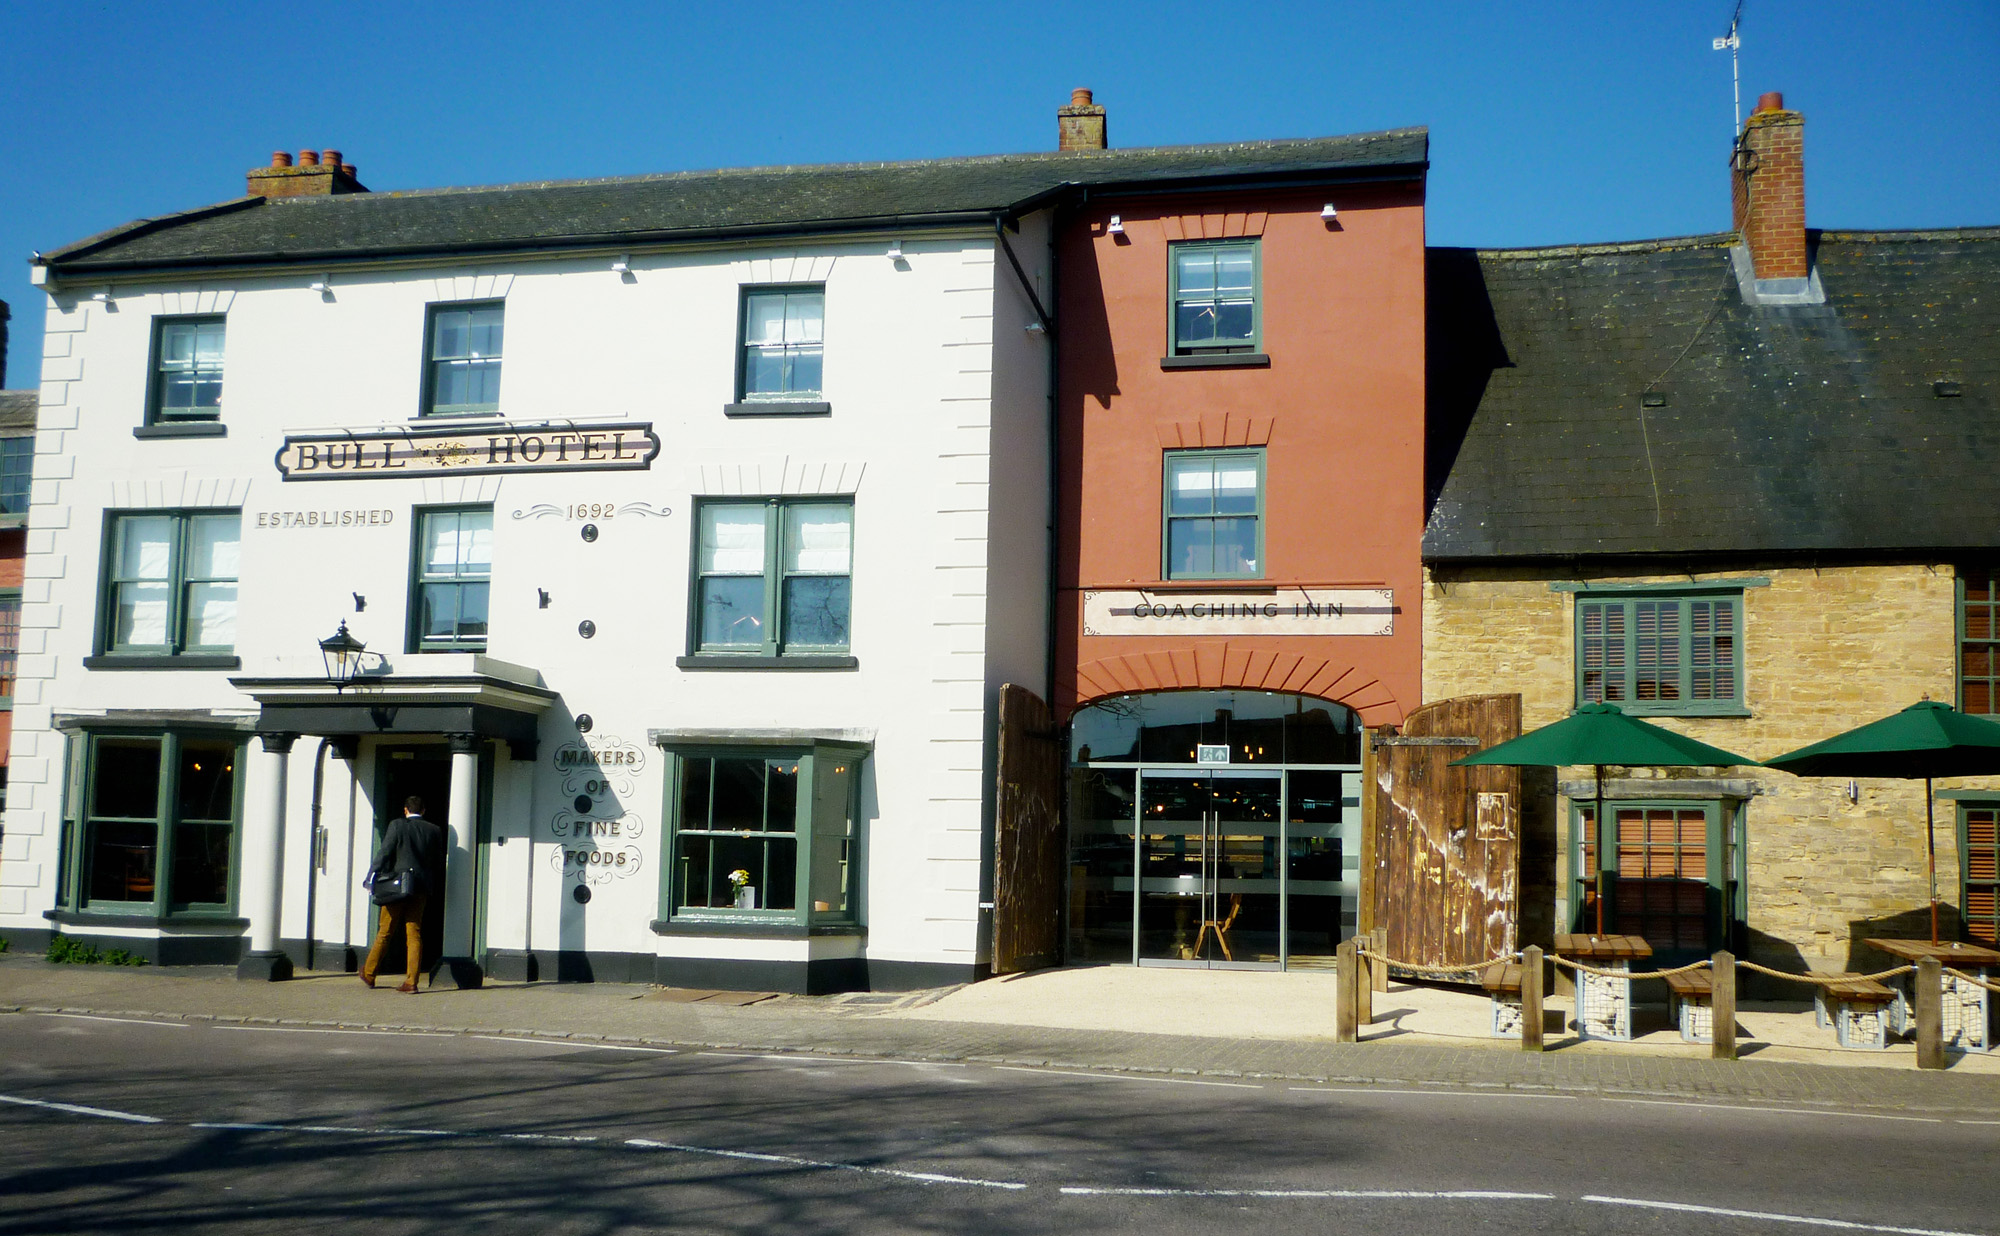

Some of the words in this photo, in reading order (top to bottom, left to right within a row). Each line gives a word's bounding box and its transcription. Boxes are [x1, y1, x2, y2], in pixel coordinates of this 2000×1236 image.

[294, 442, 407, 472] BULL
[486, 432, 638, 465] HOTEL
[256, 509, 395, 528] ESTABLISHED
[567, 502, 615, 520] 1692
[1133, 602, 1279, 619] COACHING
[1293, 602, 1345, 619] INN
[561, 750, 636, 766] MAKERS
[586, 779, 610, 795] OF
[573, 821, 621, 837] FINE
[564, 850, 627, 867] FOODS
